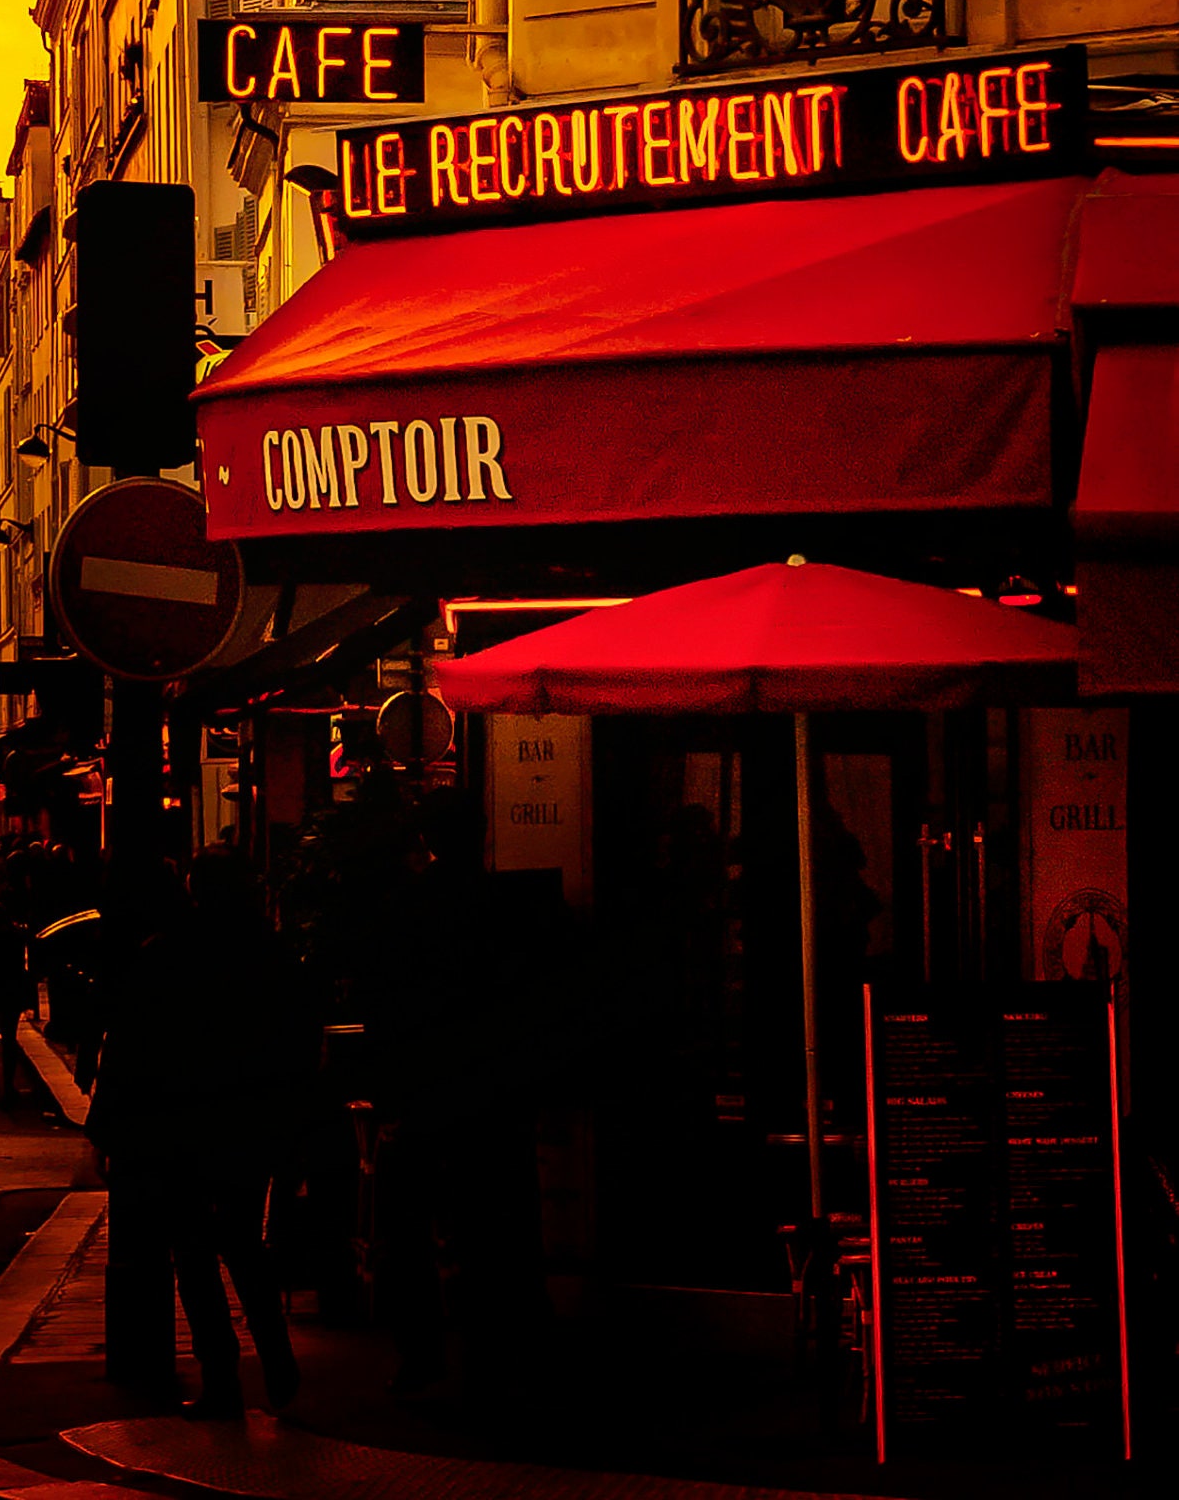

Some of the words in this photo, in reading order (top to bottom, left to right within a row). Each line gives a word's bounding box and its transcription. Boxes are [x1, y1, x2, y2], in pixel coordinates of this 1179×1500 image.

[226, 24, 400, 100] CAFE
[342, 132, 416, 218] LE
[428, 85, 838, 208] RECRUTEMENT
[897, 62, 1055, 164] CAFE
[263, 415, 514, 511] COMPTOIR
[1064, 732, 1118, 761] BAR
[510, 803, 564, 825] GRILL
[1050, 804, 1124, 830] GRILL
